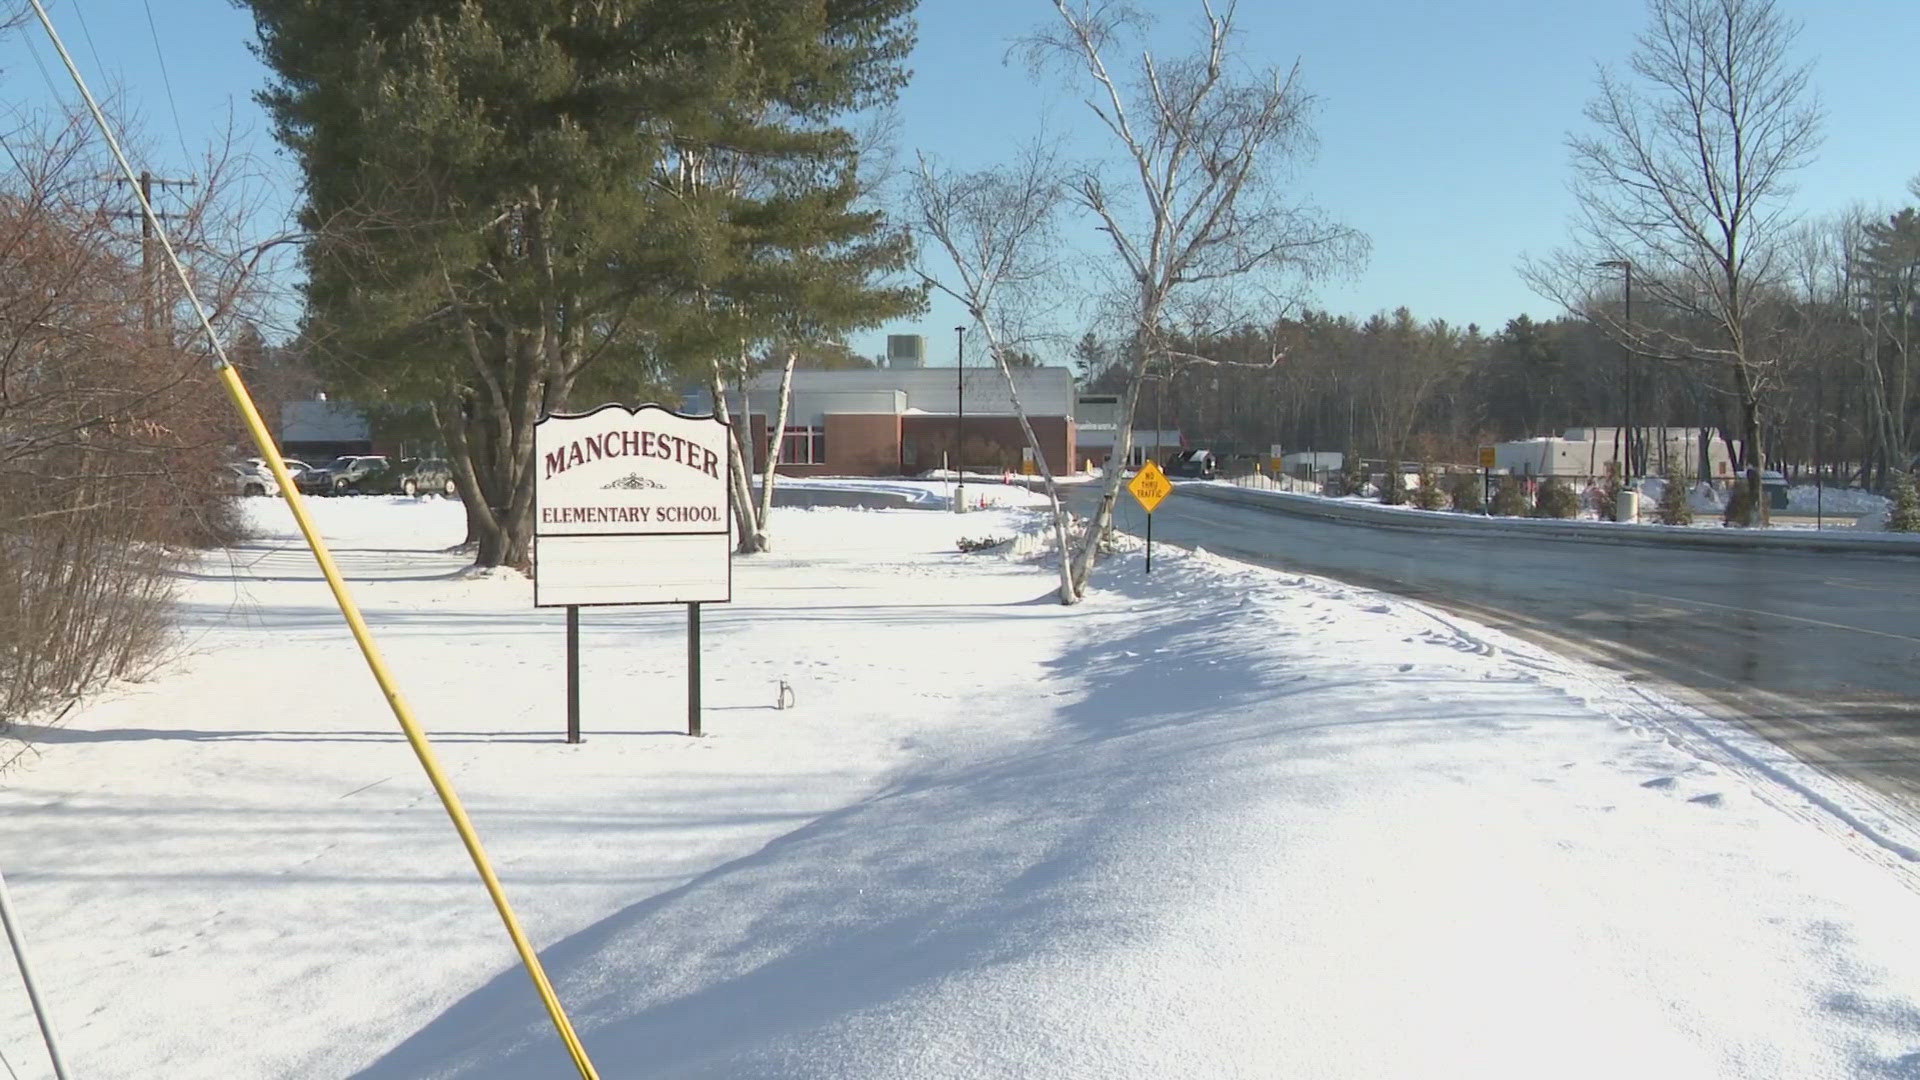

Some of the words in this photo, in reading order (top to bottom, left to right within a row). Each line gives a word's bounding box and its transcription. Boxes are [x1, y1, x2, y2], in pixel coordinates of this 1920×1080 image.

[545, 431, 719, 480] MANCHESTER
[543, 507, 650, 523] ELEMENTARY
[656, 506, 721, 522] SCHOOL
